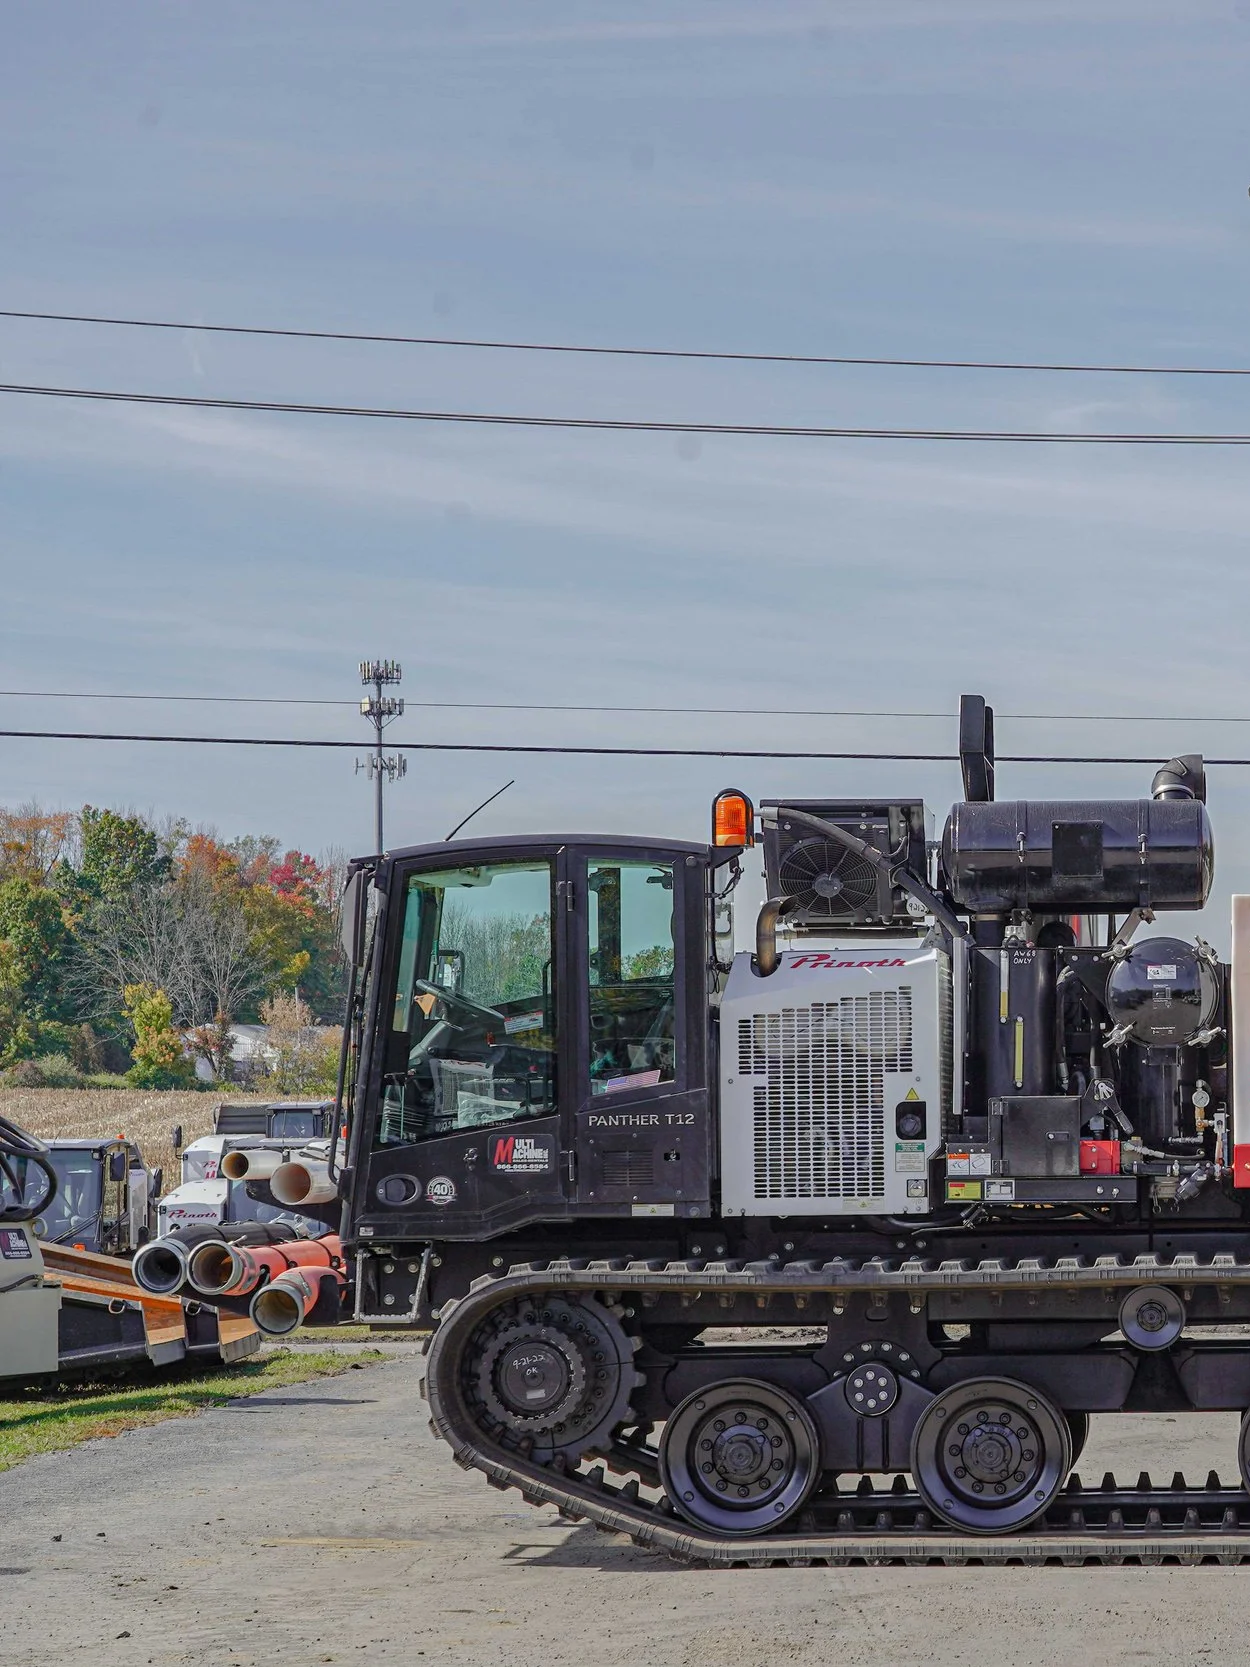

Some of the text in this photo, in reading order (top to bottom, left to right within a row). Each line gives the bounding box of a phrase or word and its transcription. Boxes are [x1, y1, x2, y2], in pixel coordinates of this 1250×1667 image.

[788, 954, 907, 969] Prinoth
[588, 1113, 695, 1126] PANTHER T12
[433, 1184, 449, 1196] 40
[168, 1209, 218, 1218] Prinoth
[526, 1367, 538, 1376] OK
